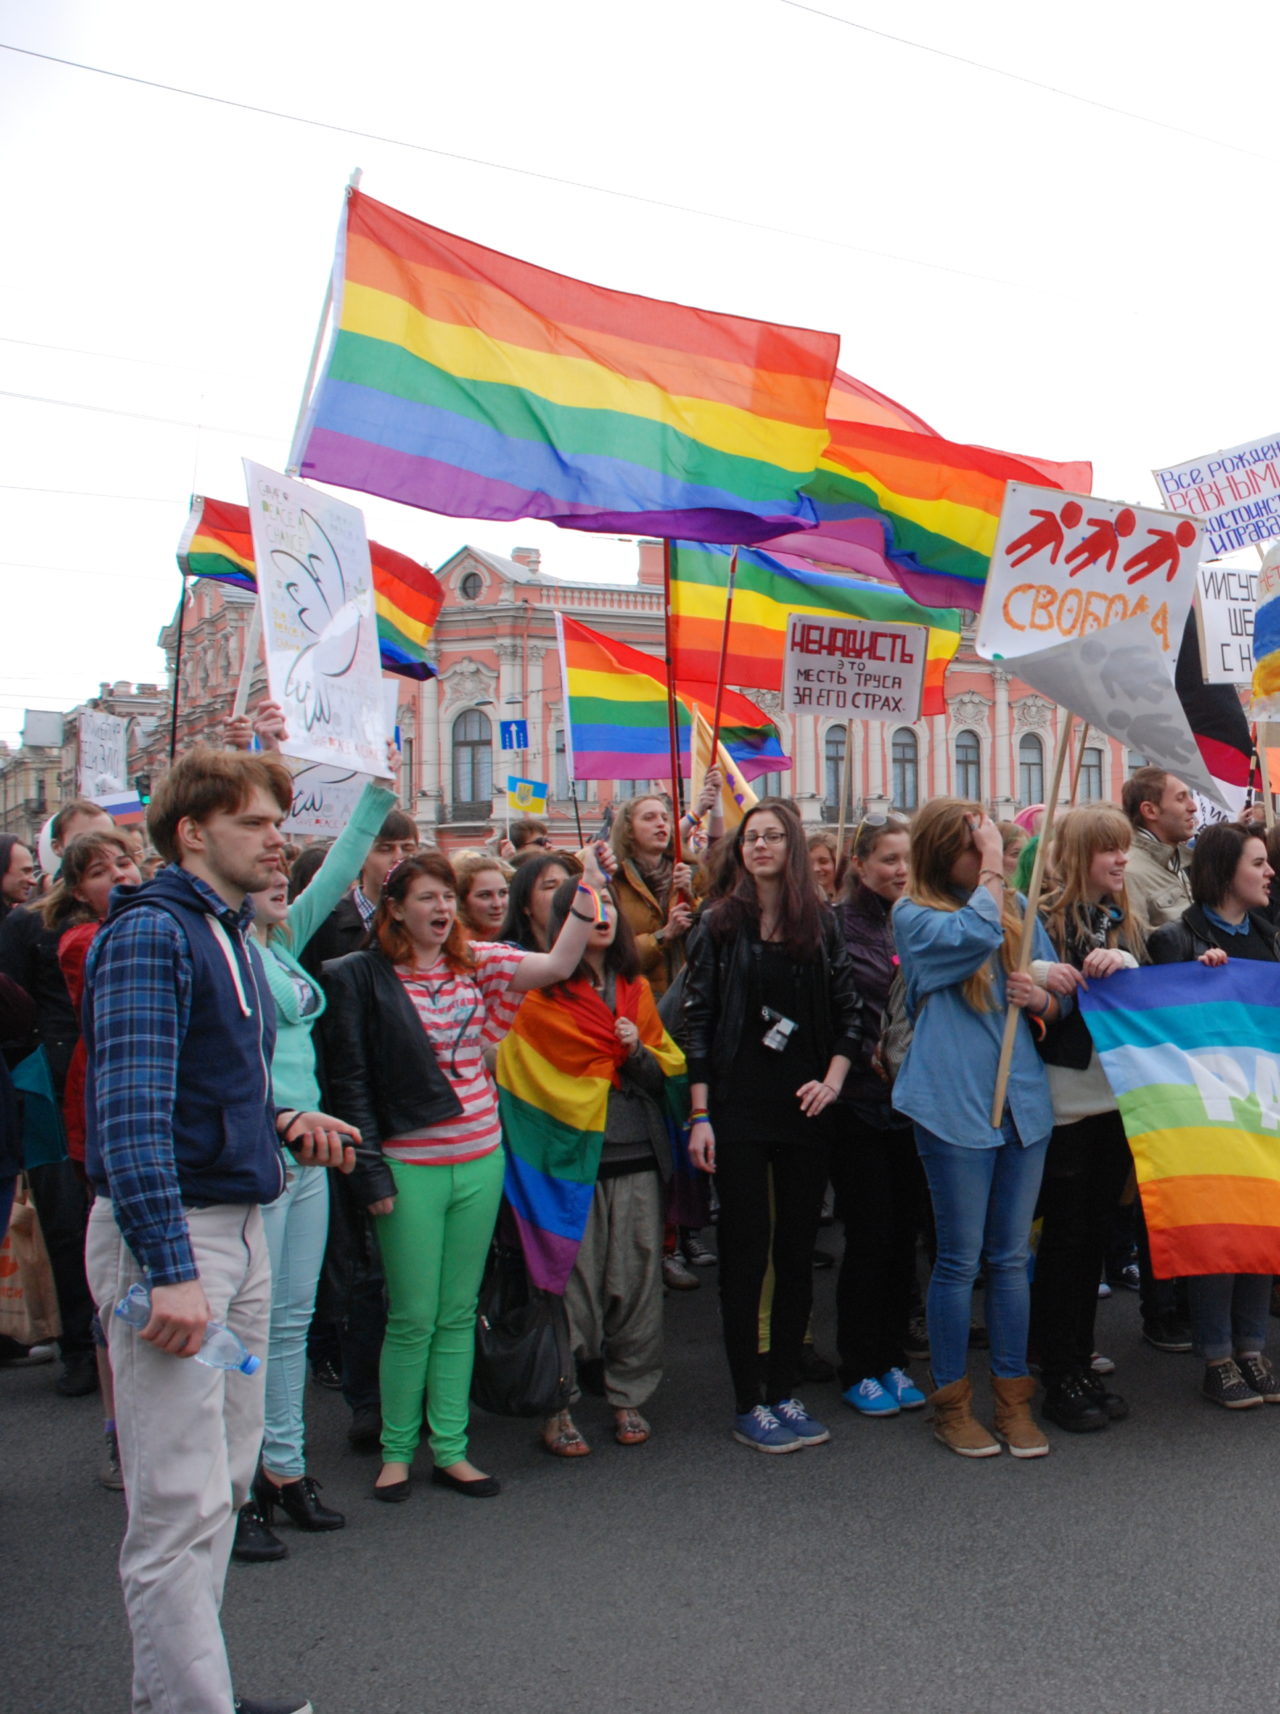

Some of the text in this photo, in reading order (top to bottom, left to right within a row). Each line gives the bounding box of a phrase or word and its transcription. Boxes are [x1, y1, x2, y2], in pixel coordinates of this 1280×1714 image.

[791, 622, 914, 664] НЕНАВИСТЬ
[837, 659, 866, 672] ЭТО
[796, 668, 902, 689] МЕСТЬ ТРУСА
[793, 686, 906, 713] ЗА ЕГО СТРАХ.
